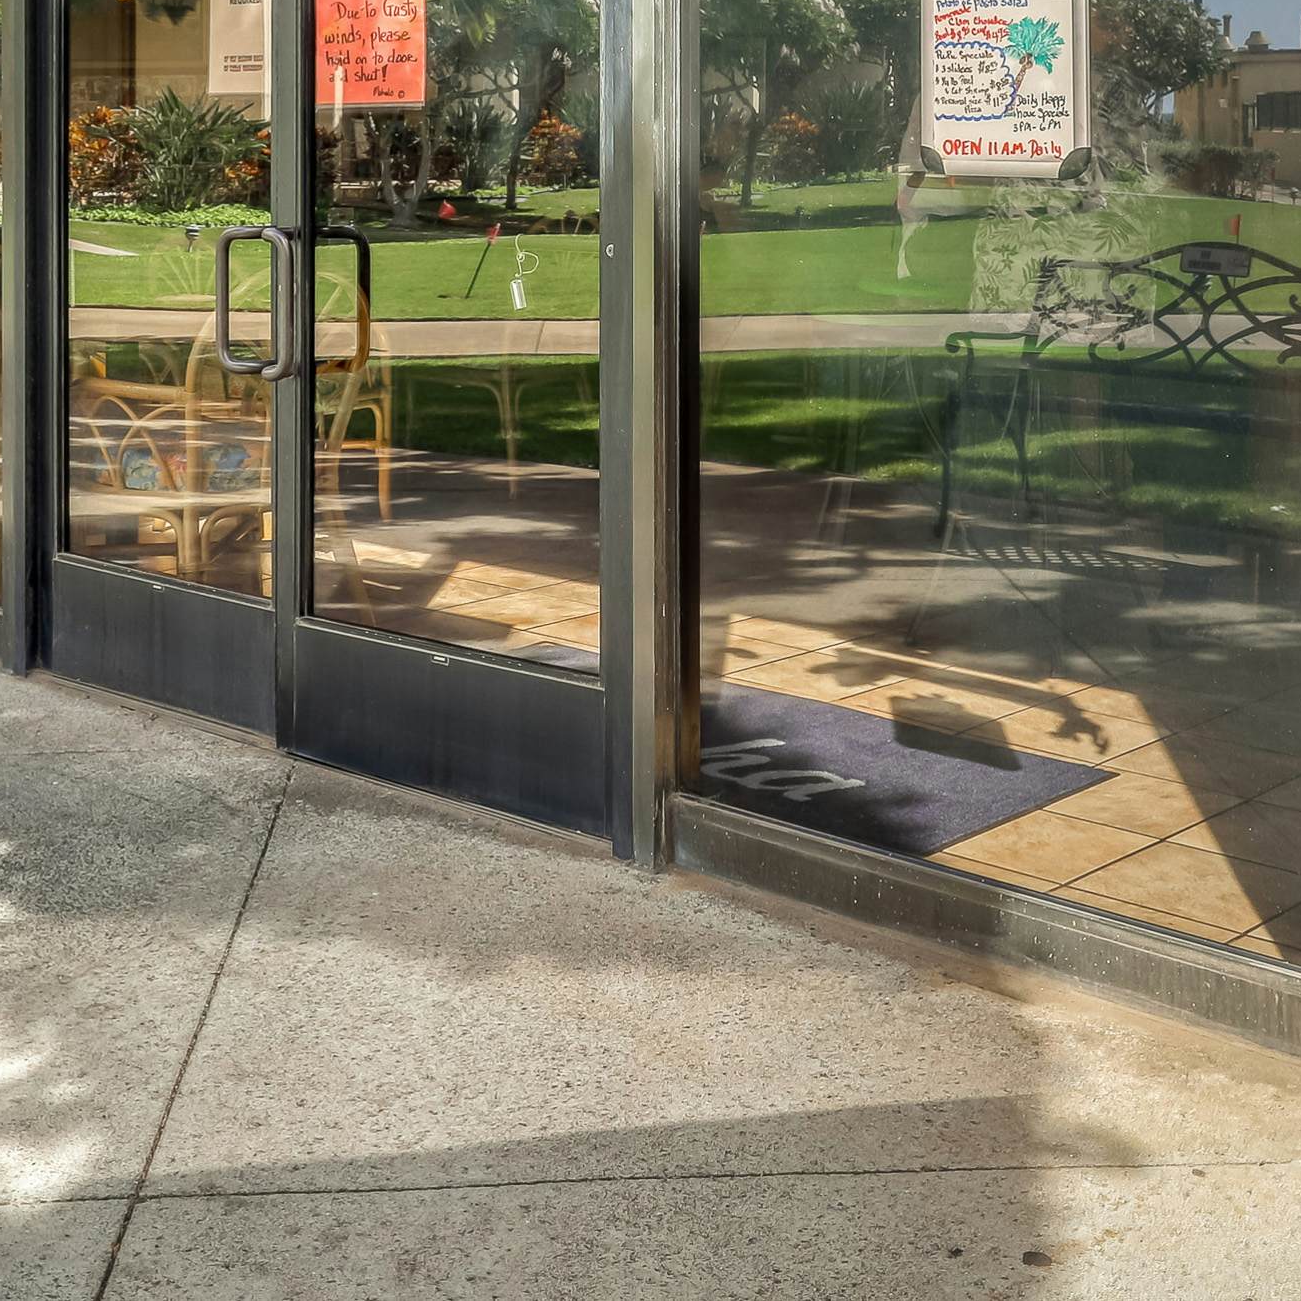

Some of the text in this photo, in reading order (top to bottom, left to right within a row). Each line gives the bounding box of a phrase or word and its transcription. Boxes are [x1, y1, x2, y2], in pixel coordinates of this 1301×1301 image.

[331, 1, 360, 19] Due
[361, 0, 377, 18] to
[324, 24, 412, 50] winds, please
[325, 48, 418, 66] hold on to door
[329, 67, 348, 83] ad
[1041, 91, 1066, 108] Happy
[943, 137, 982, 156] OPEN
[988, 141, 998, 155] 11
[1028, 139, 1063, 160] Daily
